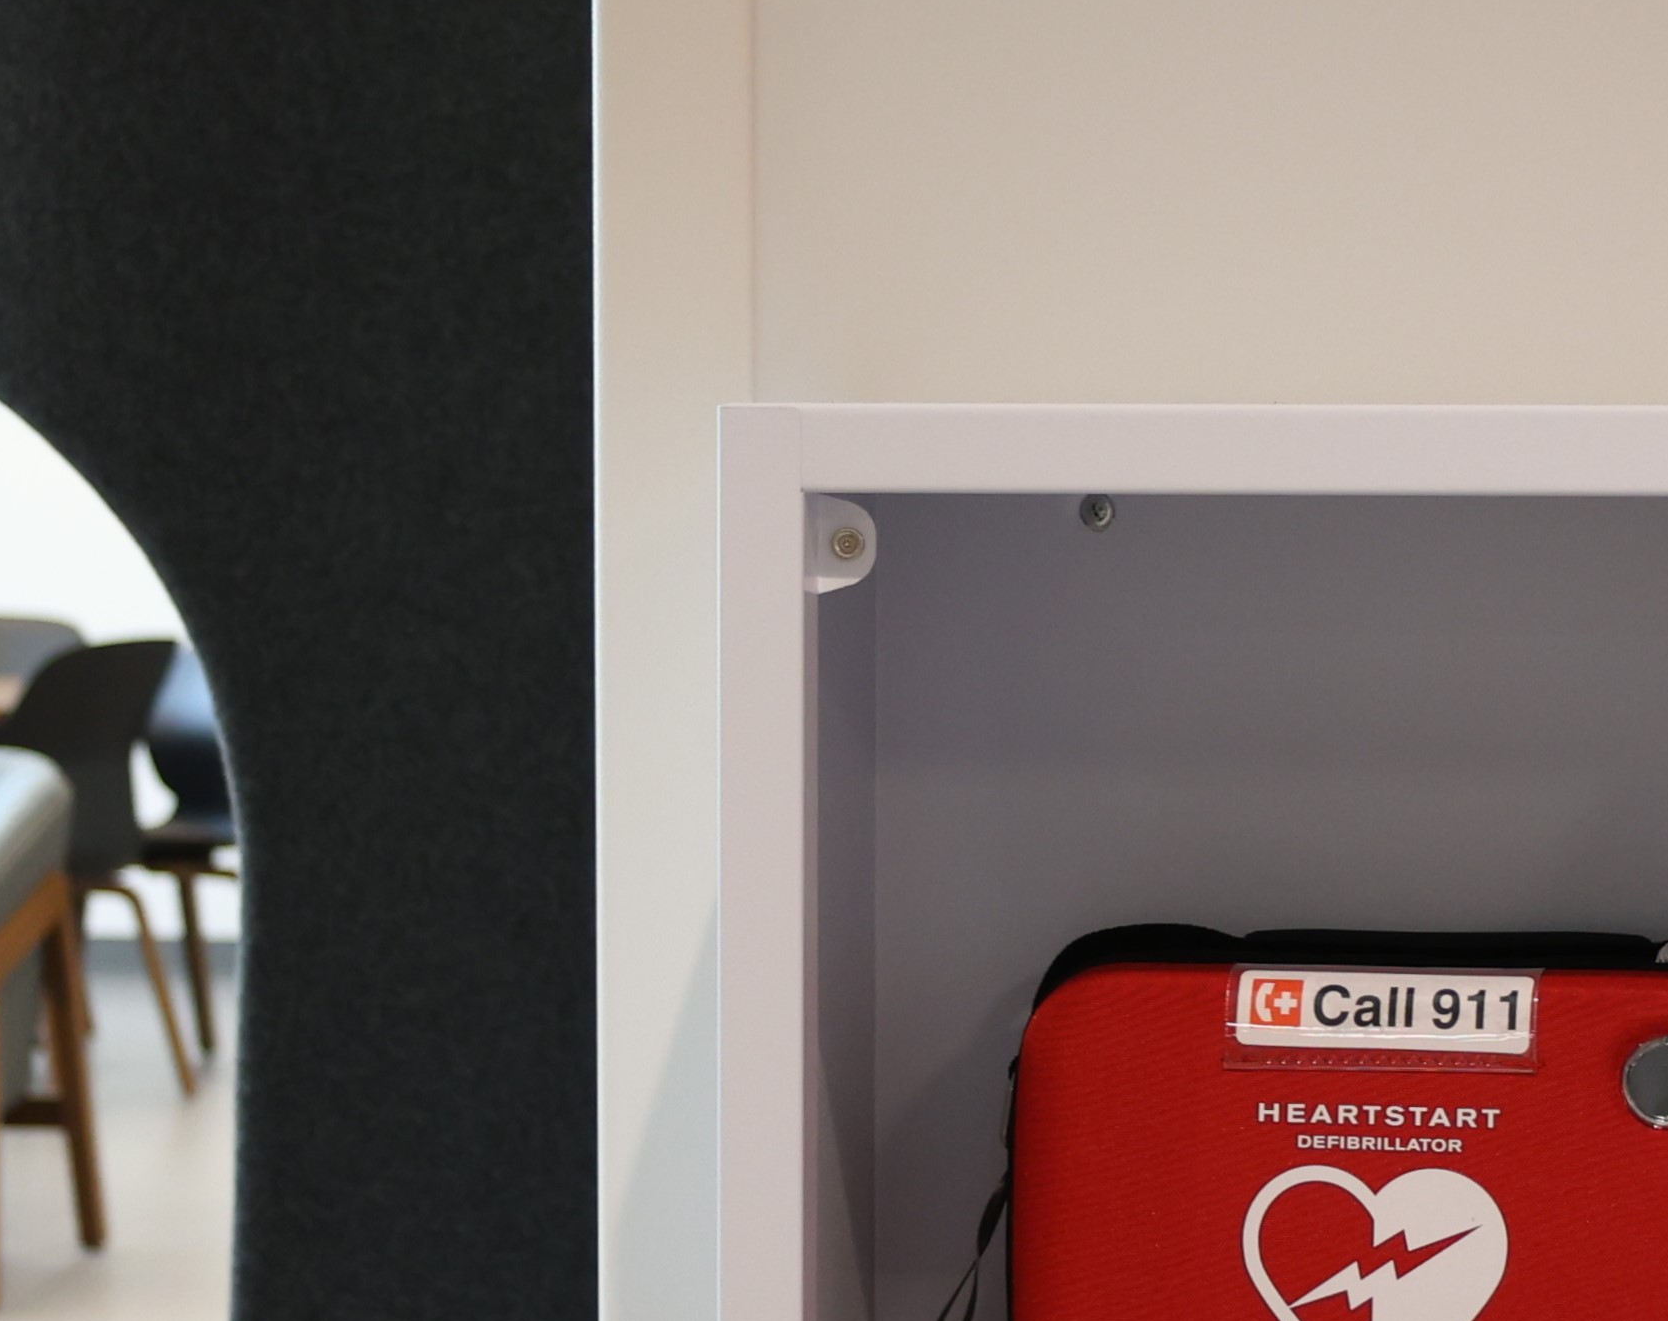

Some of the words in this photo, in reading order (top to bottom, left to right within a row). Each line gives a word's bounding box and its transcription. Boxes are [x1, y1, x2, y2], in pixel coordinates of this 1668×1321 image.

[1313, 984, 1414, 1028] Call
[1432, 988, 1519, 1031] 911
[1257, 1103, 1501, 1128] HEARTSTART
[1296, 1134, 1463, 1154] DEFIBRILLATOR
